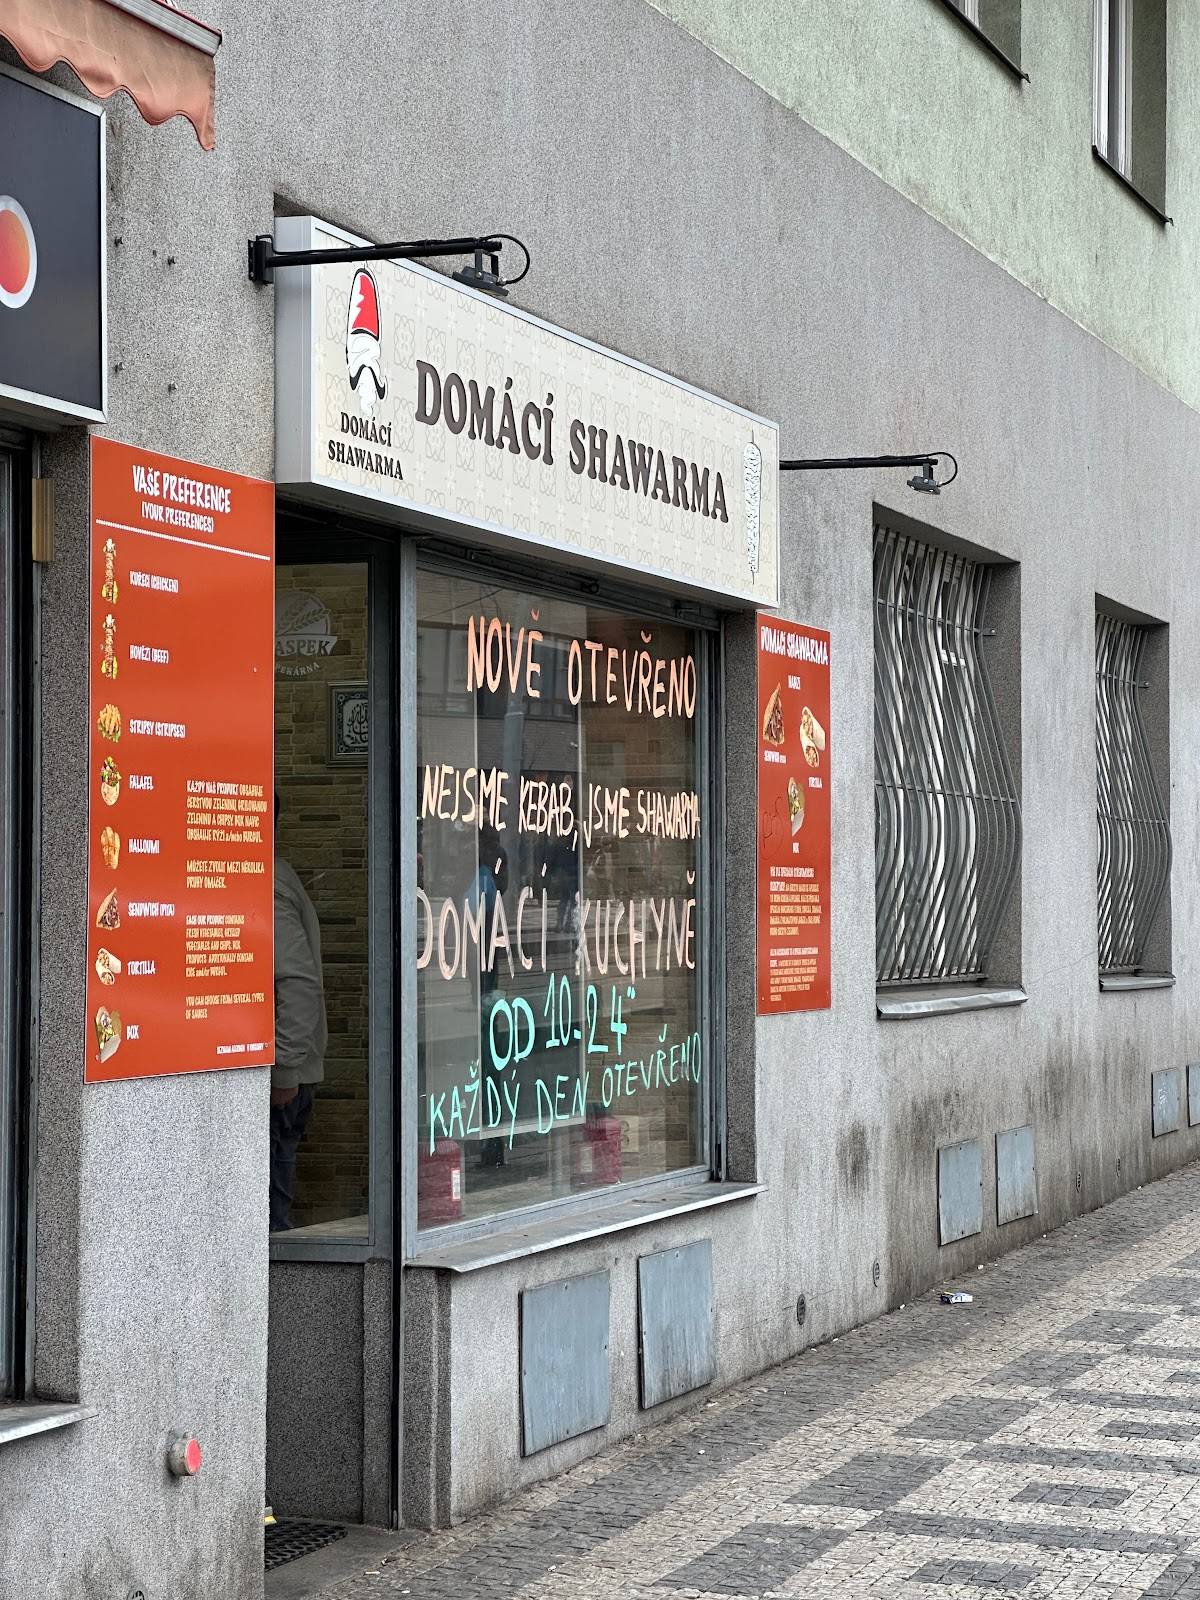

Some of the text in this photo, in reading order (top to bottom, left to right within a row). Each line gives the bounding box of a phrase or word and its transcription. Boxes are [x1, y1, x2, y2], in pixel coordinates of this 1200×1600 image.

[340, 411, 392, 447] DOMÁCÍ
[415, 360, 729, 524] DOMÁCÍ SHAWARMA
[327, 440, 404, 480] SHAWARMA
[132, 465, 231, 513] VAŠE PREFERENCE
[466, 607, 697, 718] NOVĚ OTEVŘENO
[786, 632, 829, 665] SHAWARMA
[129, 774, 154, 790] FALAFEL
[421, 763, 509, 831] NEJSME
[584, 783, 630, 849] JSME
[417, 857, 697, 984] DOMÁCÍ KUCHYNĚ
[127, 960, 156, 976] TORTILLA
[126, 1025, 140, 1040] BOX
[489, 997, 536, 1071] OD
[430, 1024, 702, 1157] KAŽDÝ DEN OTEVŘENO
